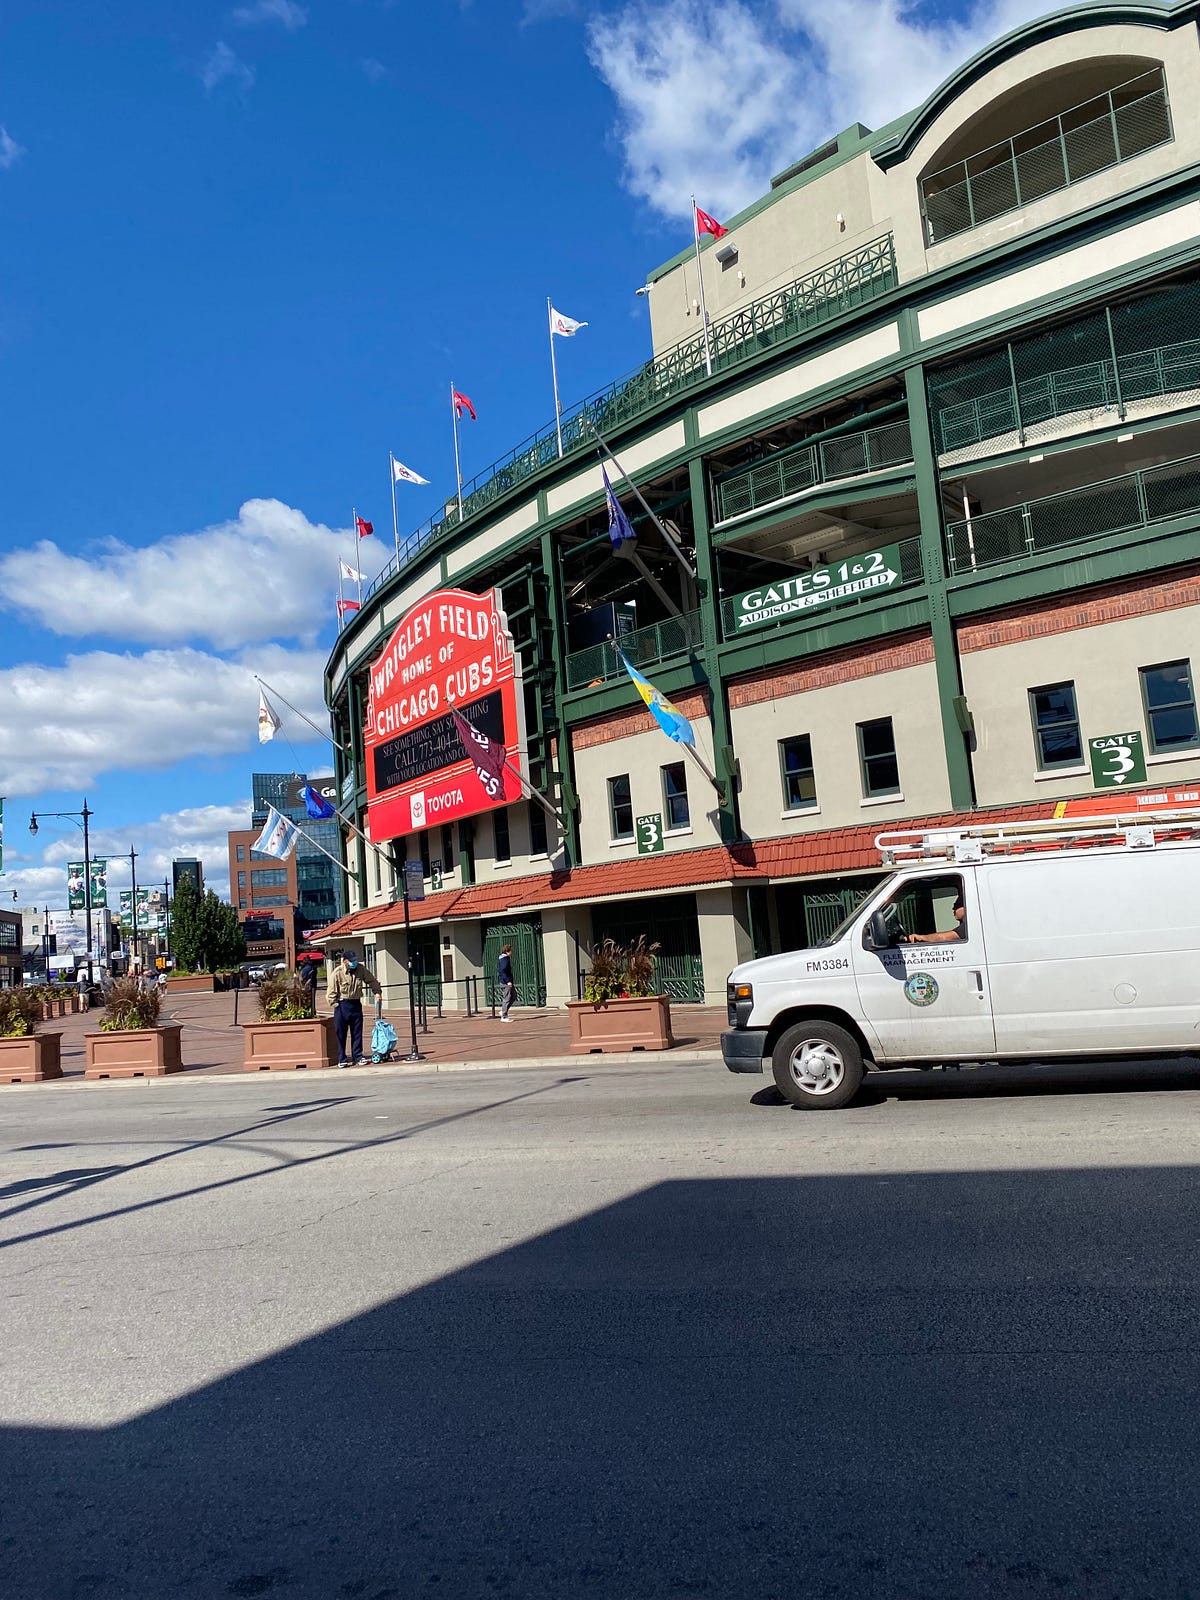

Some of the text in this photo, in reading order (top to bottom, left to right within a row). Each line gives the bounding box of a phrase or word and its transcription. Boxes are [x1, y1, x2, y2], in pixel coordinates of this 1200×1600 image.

[742, 569, 831, 610] GATES
[743, 573, 888, 624] ADDISON & SHEFFIELD
[374, 605, 489, 699] WRIGLEY FIELD
[402, 642, 454, 685] HOME OF
[377, 655, 493, 736] CHICAGO CUBS
[383, 744, 394, 758] SEE
[432, 720, 445, 738] SAY
[1092, 734, 1138, 748] GATE
[387, 772, 400, 785] WITH
[400, 766, 415, 780] YOUR
[416, 755, 444, 775] LOCATION
[445, 751, 458, 767] AND
[394, 748, 418, 770] CALL
[1101, 746, 1134, 775] 3
[427, 789, 464, 813] TOYOTA
[638, 815, 660, 824] GATE
[642, 824, 658, 845] 3
[433, 868, 440, 883] 3
[807, 959, 848, 972] FM3384
[884, 957, 956, 966] MANAGEMENT
